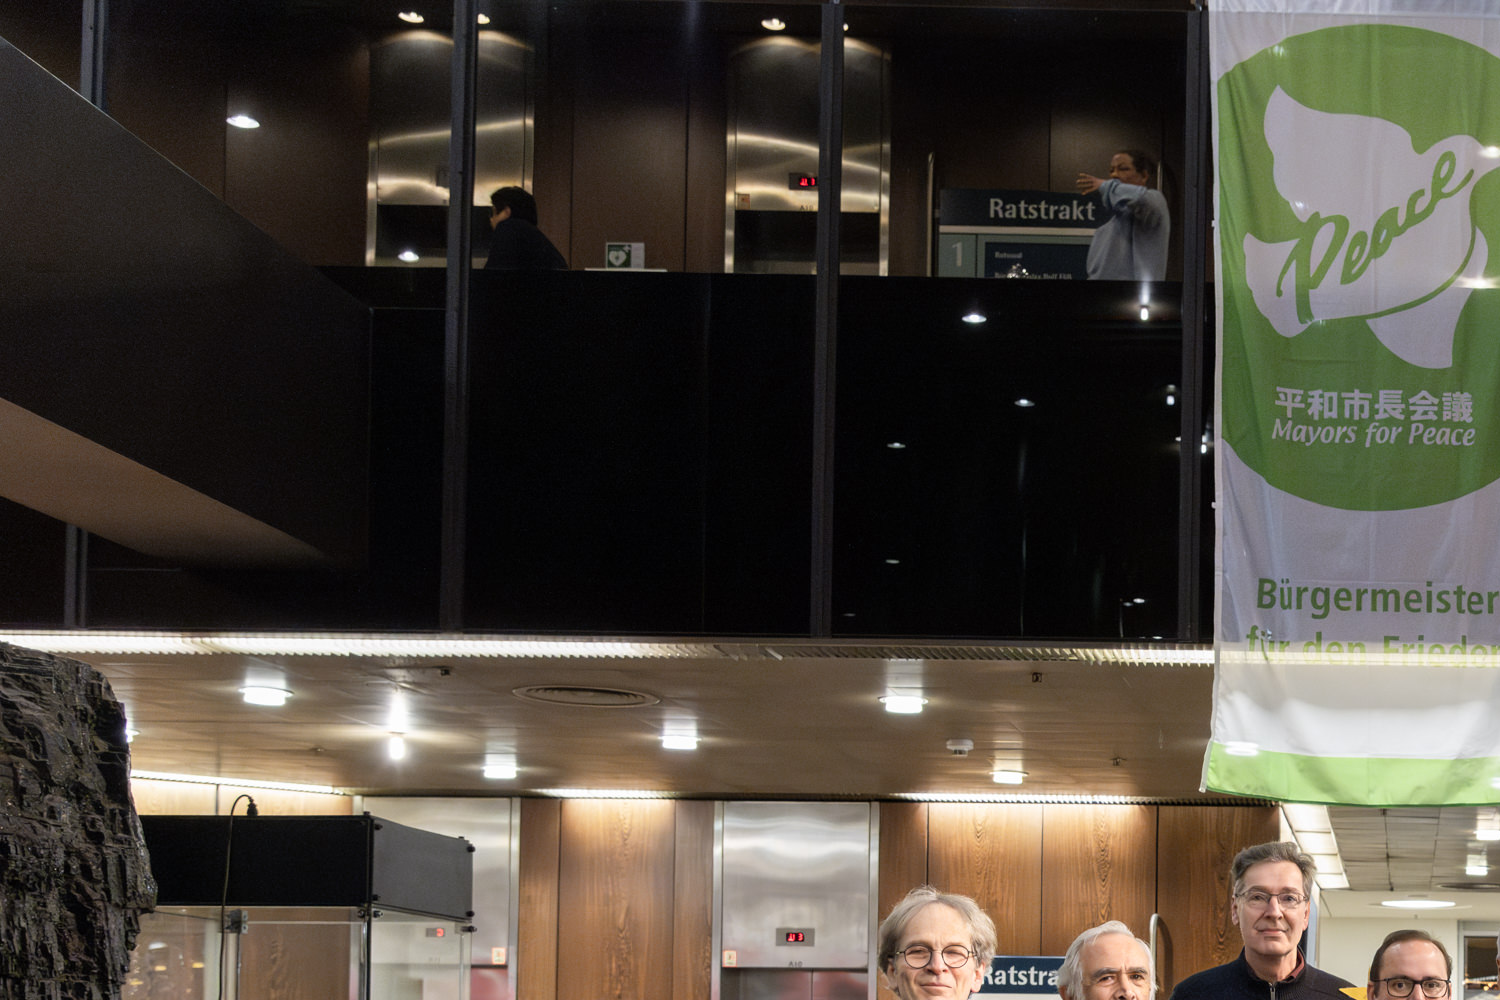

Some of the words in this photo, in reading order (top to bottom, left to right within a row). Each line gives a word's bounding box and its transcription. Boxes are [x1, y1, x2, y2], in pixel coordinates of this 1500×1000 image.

[989, 197, 1096, 221] Ratstrakt
[951, 240, 963, 267] 1
[1275, 150, 1475, 324] Peace
[1275, 386, 1474, 423] 平和市長会議
[1272, 418, 1358, 446] Mayors
[1365, 422, 1402, 447] for
[1408, 422, 1477, 446] Peace
[1256, 577, 1500, 620] Bürgermeister
[1302, 631, 1367, 666] den
